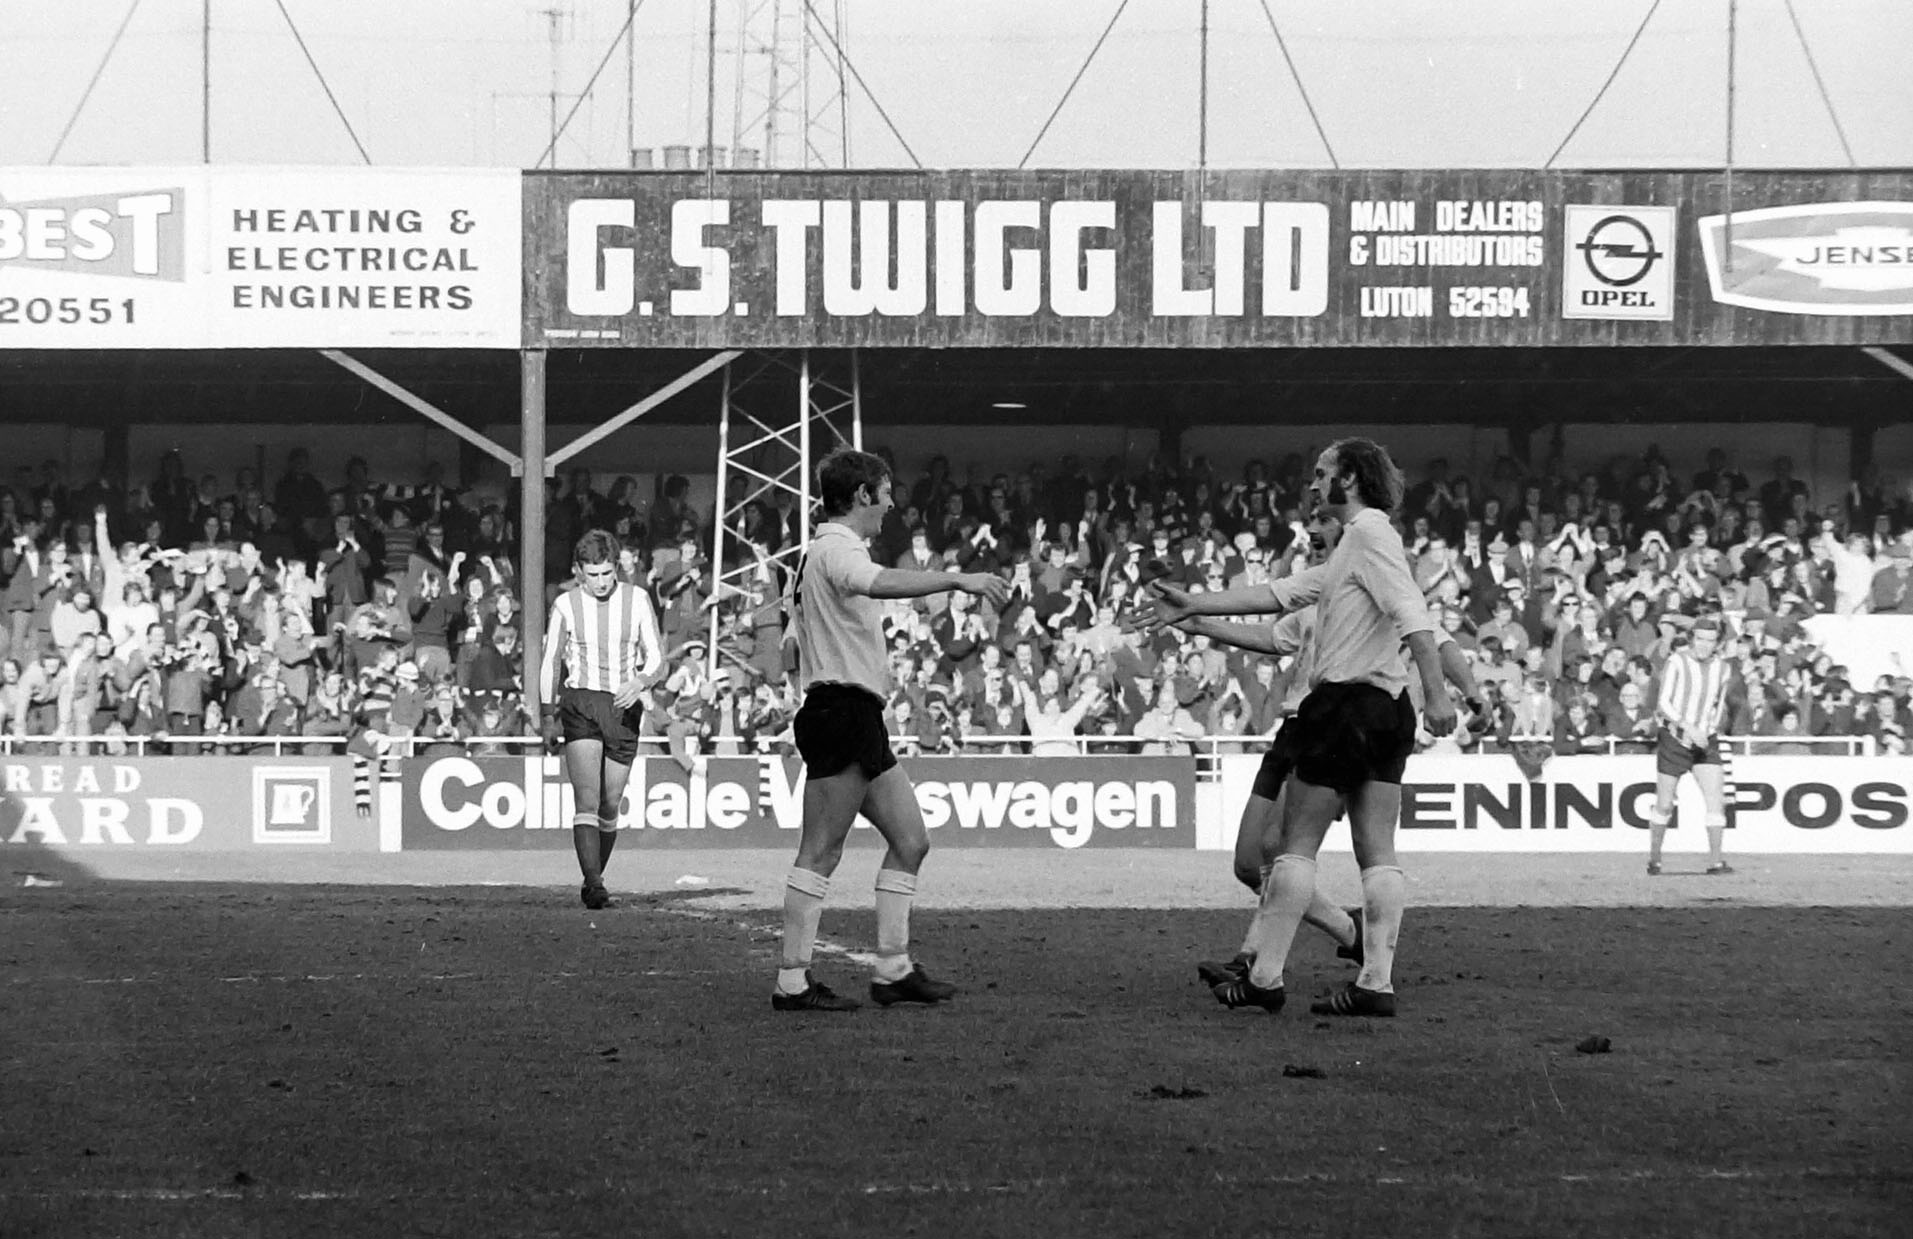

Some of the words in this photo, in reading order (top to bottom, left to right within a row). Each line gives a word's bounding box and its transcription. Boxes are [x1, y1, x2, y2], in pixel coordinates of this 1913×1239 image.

[234, 209, 423, 233] HEATING
[450, 209, 476, 234] &
[1351, 201, 1416, 232] MAIN
[1437, 201, 1545, 232] DEALERS
[0, 194, 172, 275] BEST
[228, 248, 479, 272] ELECTRICAL
[762, 200, 1116, 317] TWIGG
[1153, 201, 1329, 317] LTD
[1350, 235, 1370, 266] &
[1376, 235, 1544, 267] DISTRIBUTORS
[0, 298, 136, 325] 20551
[234, 285, 474, 310] ENGINEERS
[1360, 287, 1433, 318] LUTON
[1450, 288, 1531, 318] 52594
[1582, 291, 1656, 307] OPEL
[6, 765, 142, 793] READ
[769, 756, 1176, 848] Vswagen
[1400, 782, 1679, 830] ENING
[0, 797, 203, 845] ARD
